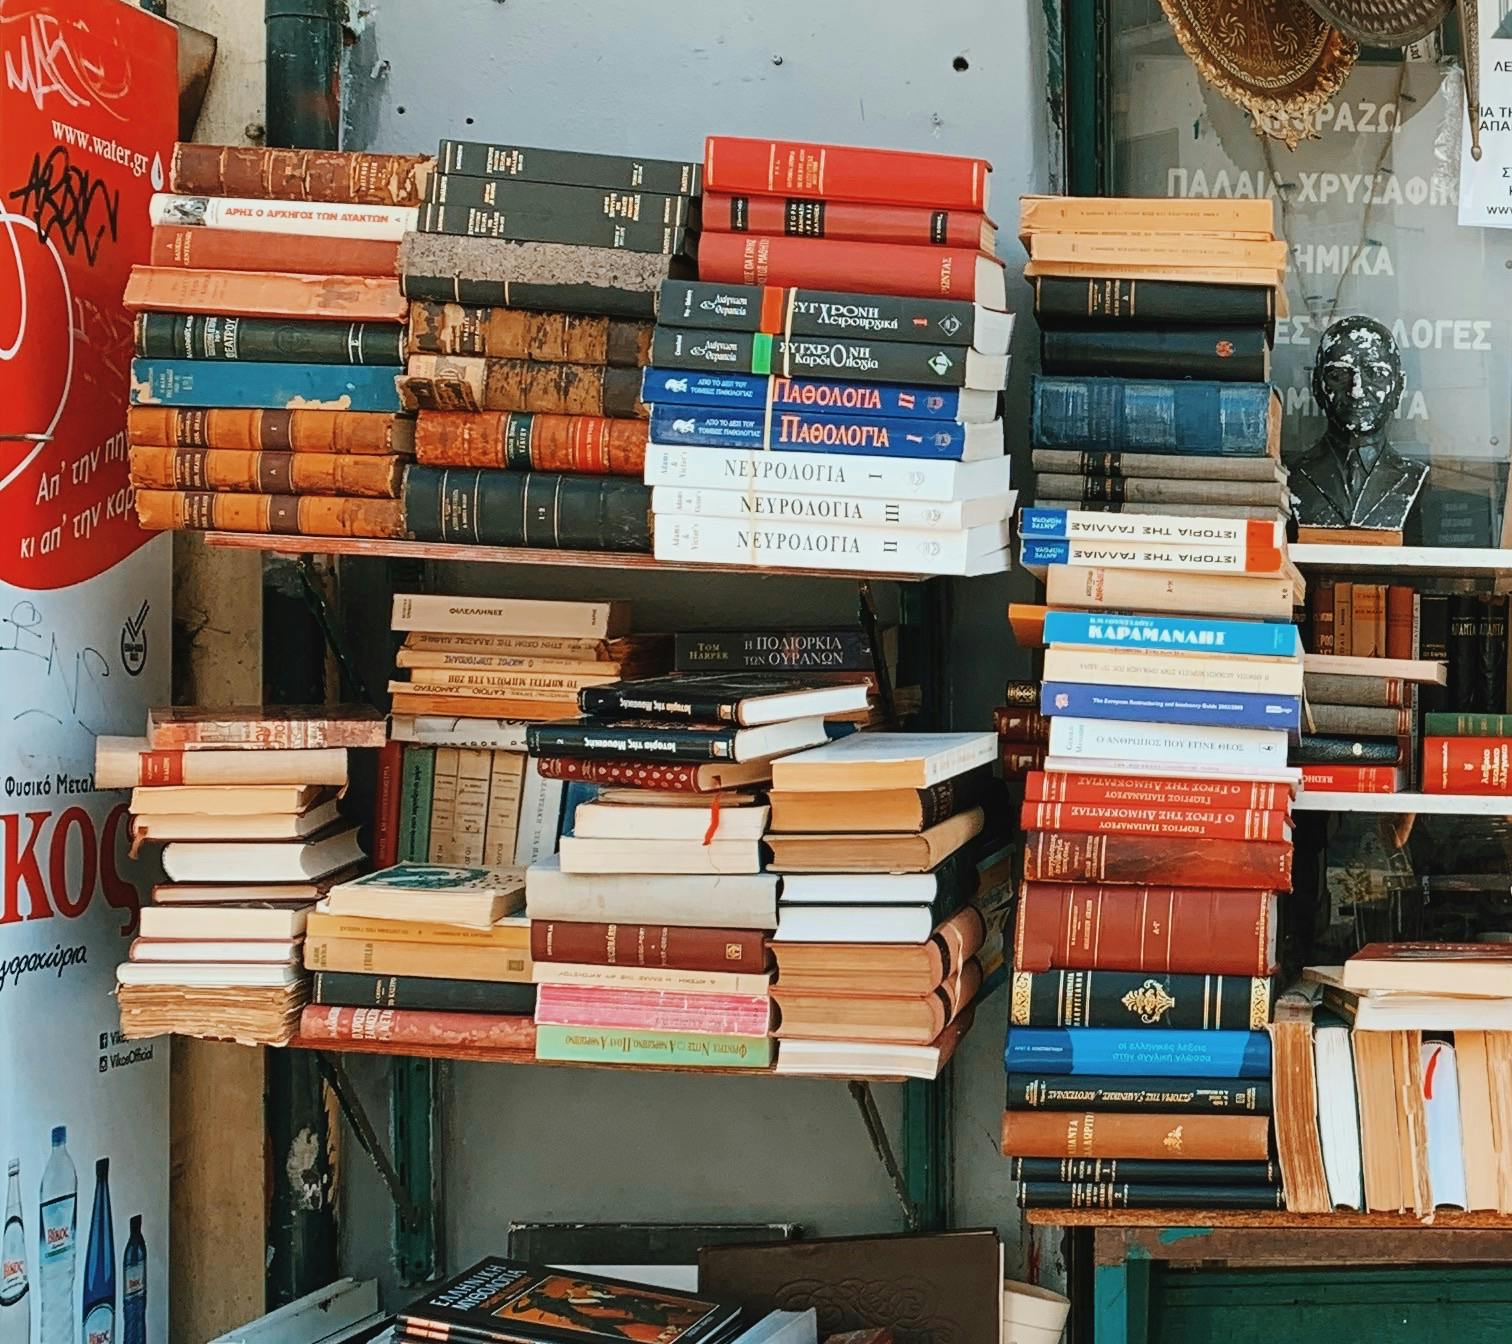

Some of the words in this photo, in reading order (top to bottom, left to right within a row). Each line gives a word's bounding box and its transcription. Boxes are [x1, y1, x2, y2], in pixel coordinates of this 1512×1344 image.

[51, 119, 149, 178] www.water.gr
[224, 207, 253, 217] ΑΡΗΣ
[266, 209, 313, 220] ΑΡΧΗΓΟΣ
[771, 376, 882, 410] ΠΑΘΟΛΟΓΙΑ
[779, 414, 890, 448] ΠΑΘΟΛΟΓΙΑ
[71, 445, 101, 485] την
[724, 459, 846, 484] ΝΕΥΡΟΛΟΓΙΑ
[740, 496, 863, 520] ΝΕΥΡΟΛΟΓΙΑ
[72, 501, 102, 540] την
[1071, 521, 1134, 534] ΓΑΛΛΙΑΣ
[1143, 525, 1171, 536] ΤΗΣ
[1180, 526, 1237, 539] ΙΣΤΟΡΙΑ
[737, 530, 861, 554] ΝΕΥΡΟΛΟΓΙΑ
[1073, 550, 1136, 560] ΓΑΛΛΙΑΣ
[1143, 552, 1172, 562] ΤΗΣ
[1179, 553, 1237, 564] ΙΣΤΟΡΙΑ
[755, 635, 843, 652] ΠΟΛΙΟΡΚΙΑ
[744, 653, 767, 666] ΤΩΝ
[769, 649, 844, 668] ΟΥΡΑΝΩΝ
[645, 740, 677, 753] Ιστορία
[4, 774, 52, 798] Φυσικό
[429, 1264, 507, 1307] ΕΛΛΗΝΙΚΗ
[451, 1268, 528, 1311] ΜΥΘΟΛΟΓΙΑ
